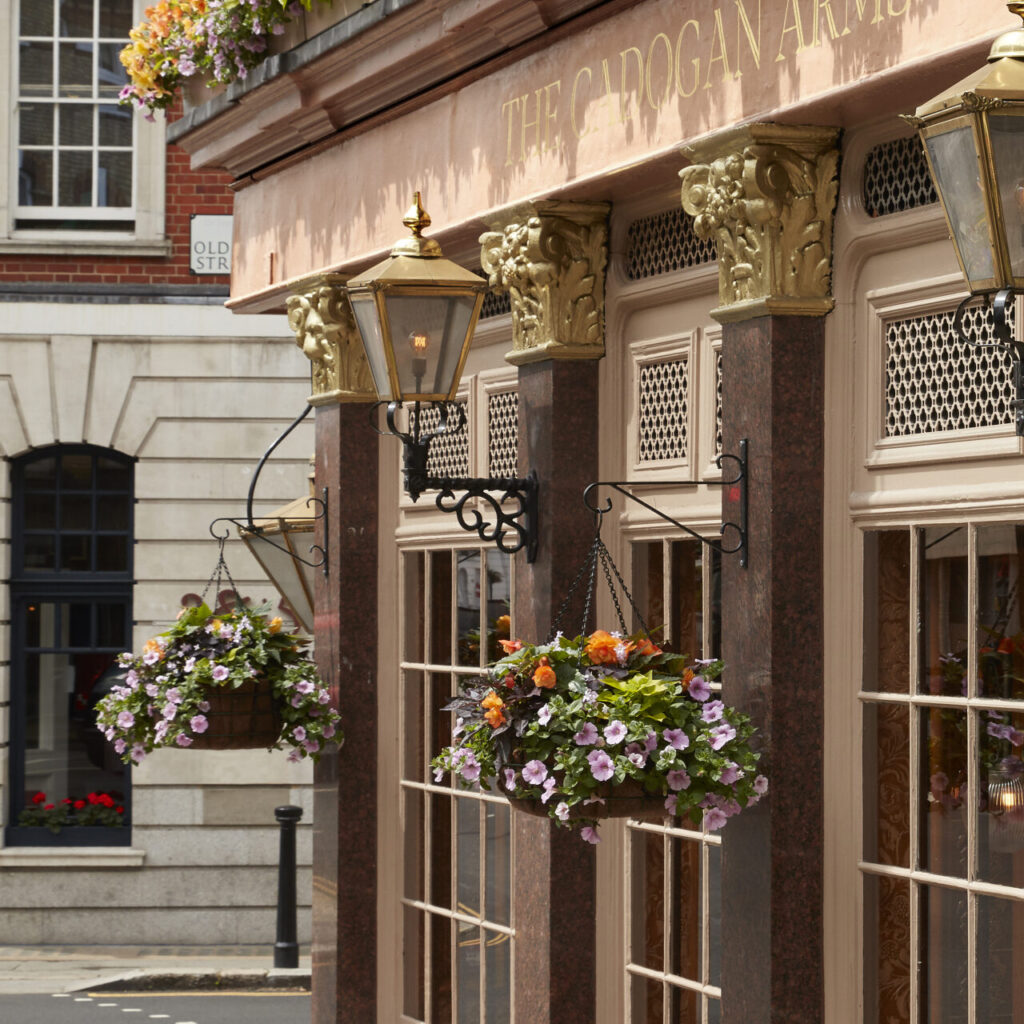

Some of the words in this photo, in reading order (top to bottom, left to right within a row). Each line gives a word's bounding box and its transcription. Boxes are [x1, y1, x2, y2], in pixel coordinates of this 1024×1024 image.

[502, 80, 561, 168] THE
[193, 240, 230, 255] OLD
[196, 256, 230, 270] STR
